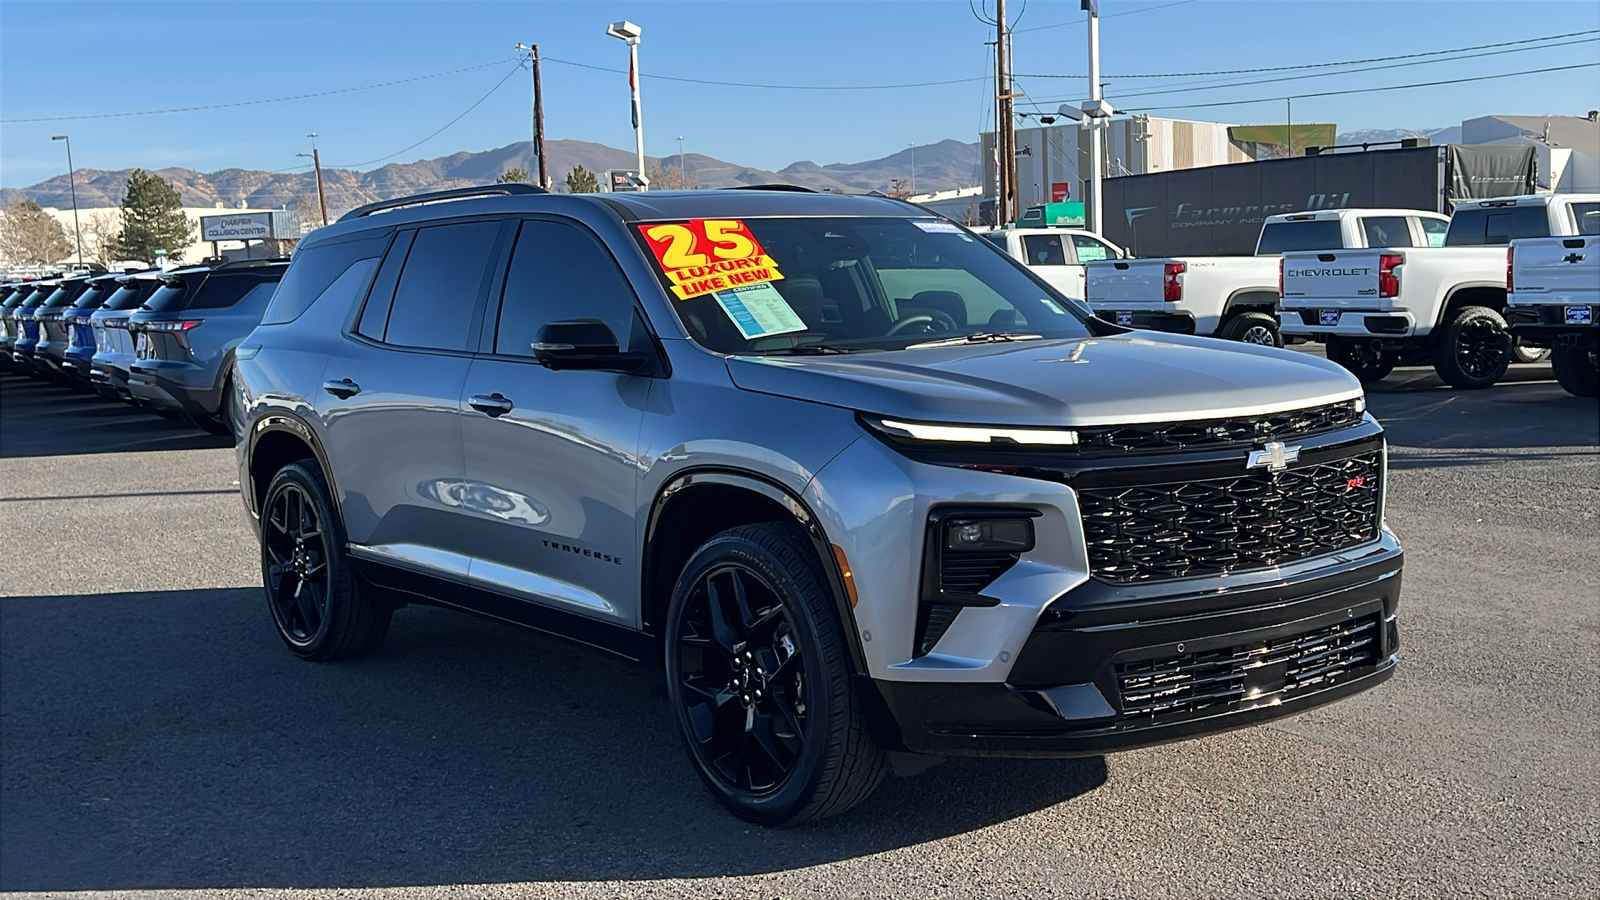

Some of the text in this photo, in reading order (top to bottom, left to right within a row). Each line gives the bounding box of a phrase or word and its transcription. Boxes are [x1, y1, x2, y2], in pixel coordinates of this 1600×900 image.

[1170, 193, 1350, 219] Farmers Oil
[208, 226, 266, 237] COLLISION CENTER
[1171, 219, 1234, 229] COMPANY
[647, 220, 759, 269] 25
[676, 256, 763, 281] LUXURY
[1288, 268, 1371, 277] CHEVROLET
[682, 268, 773, 296] LIKE NEW
[541, 539, 622, 566] TRAVERSE
